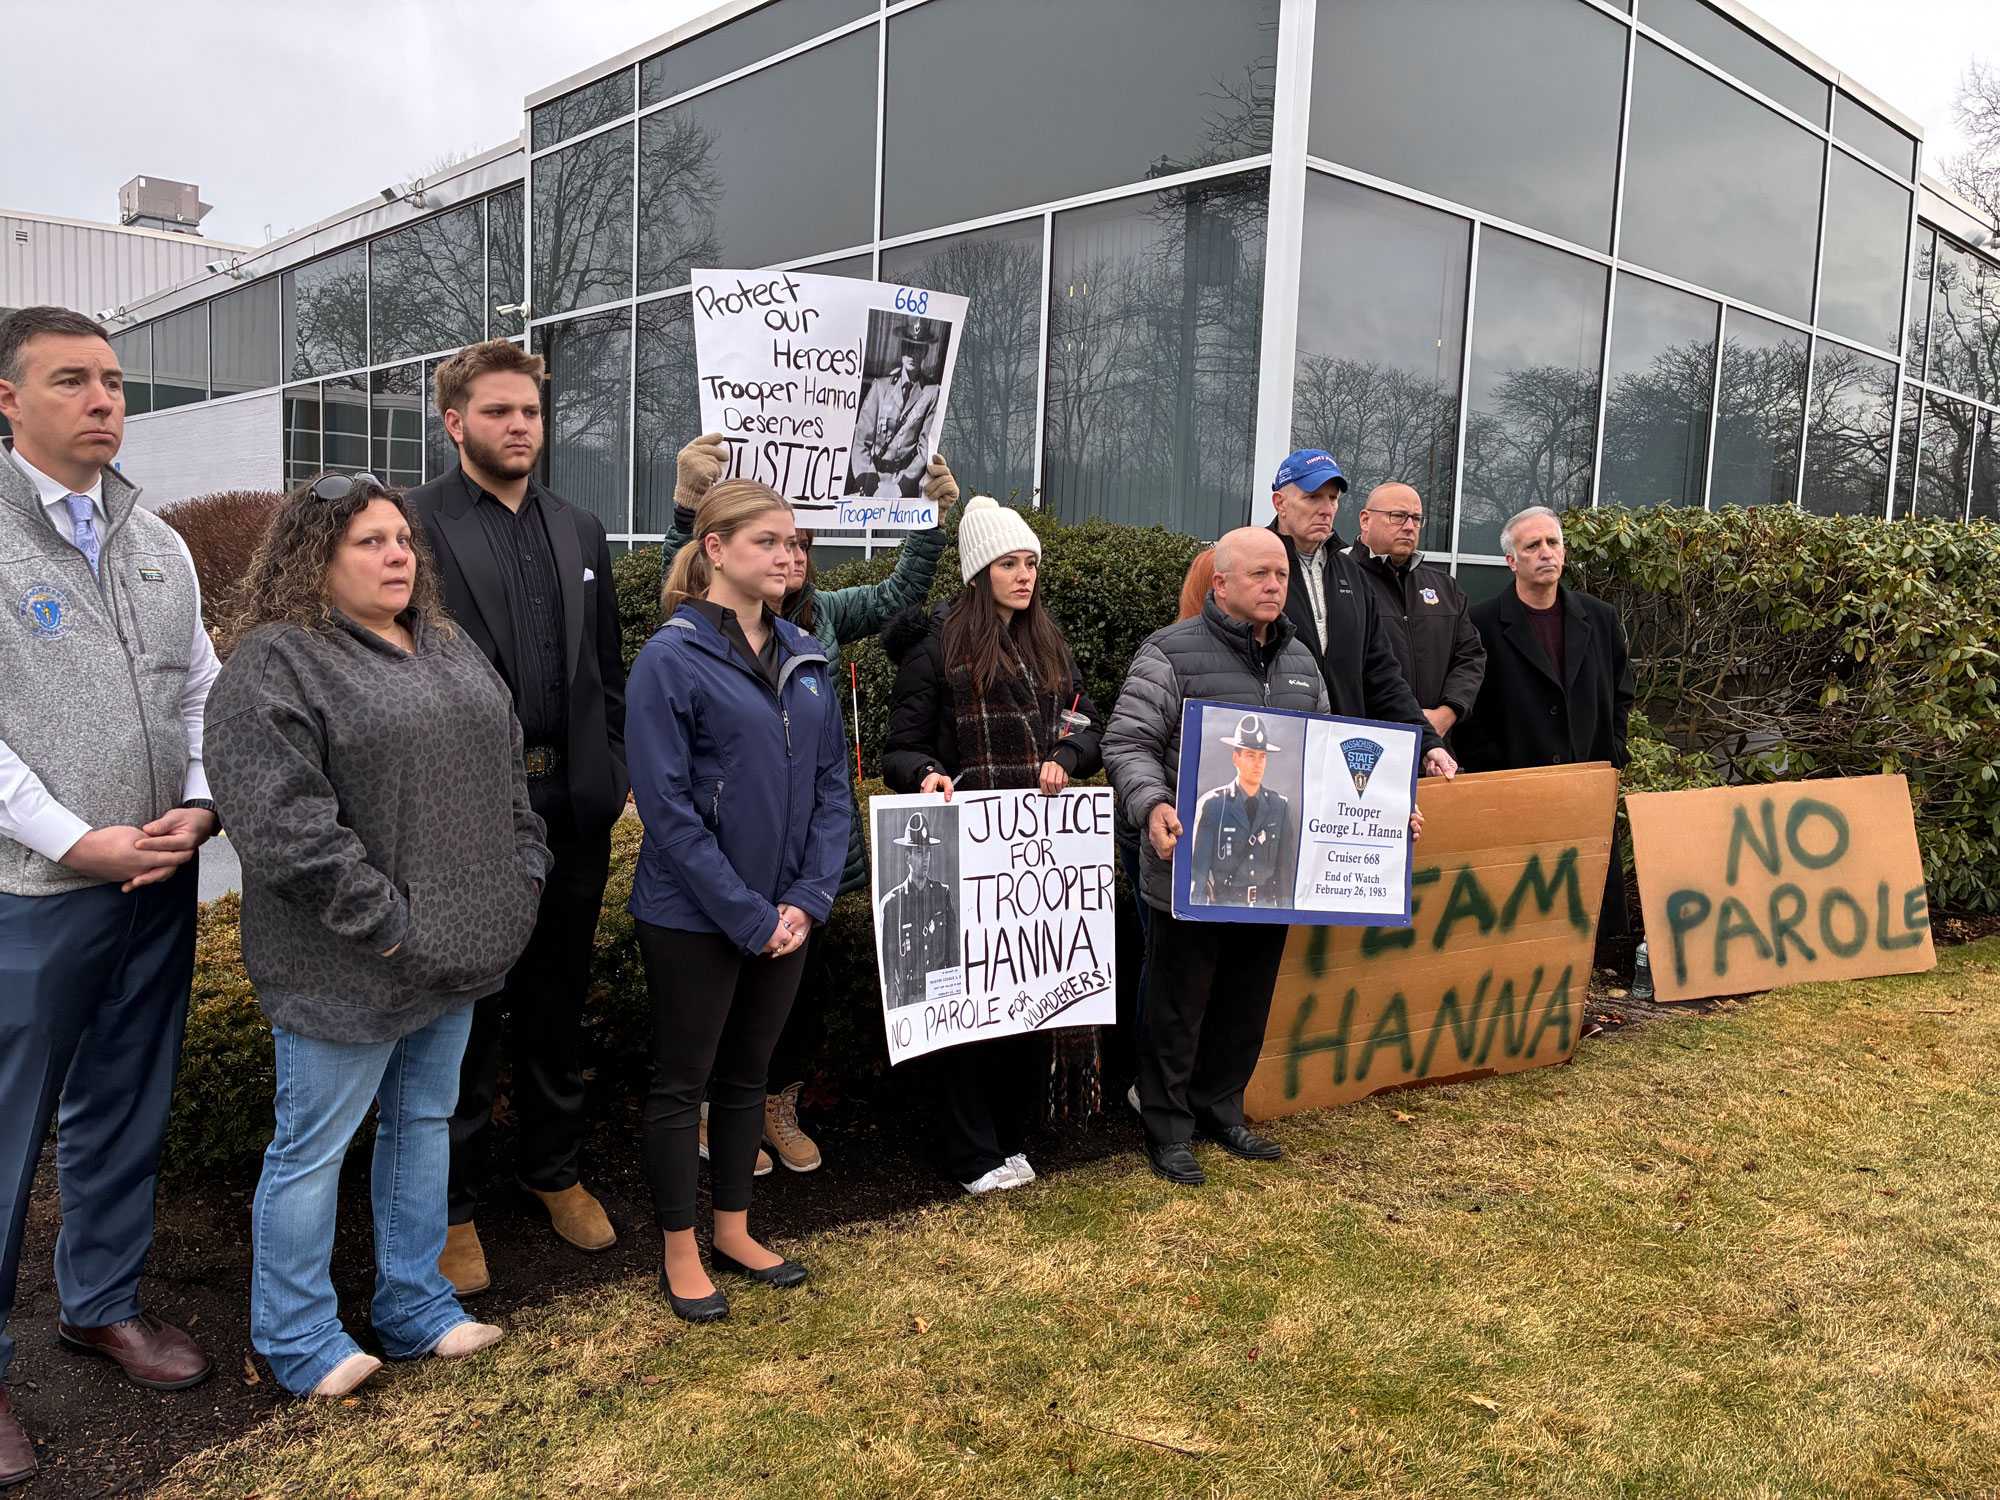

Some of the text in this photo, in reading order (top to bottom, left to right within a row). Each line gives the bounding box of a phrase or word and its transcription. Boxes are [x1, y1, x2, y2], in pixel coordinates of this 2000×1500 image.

[695, 273, 801, 320] Protect
[895, 288, 929, 314] 668
[773, 338, 863, 379] Heroes!
[702, 376, 857, 412] Trooper Hanna
[724, 407, 824, 438] Deserves
[835, 500, 934, 525] Trooper Hanna
[1347, 751, 1375, 764] STATE
[1349, 762, 1373, 771] POLICE
[964, 792, 1111, 843] JUSTICE
[1338, 802, 1381, 821] Trooper
[1309, 818, 1403, 839] George L. Hanna
[1726, 797, 1850, 887] NO
[1011, 839, 1056, 869] FOR
[1328, 850, 1380, 865] Cruiser 668
[1315, 883, 1387, 898] February 26, 1983
[1325, 871, 1380, 884] End of Watch
[963, 864, 1114, 924] TROOPER
[1665, 881, 1930, 986] PAROLE
[964, 915, 1098, 995] HANNA
[891, 963, 1112, 1051] NO PAROLE FOR MURDERERS!
[1285, 964, 1573, 1099] HANNA
